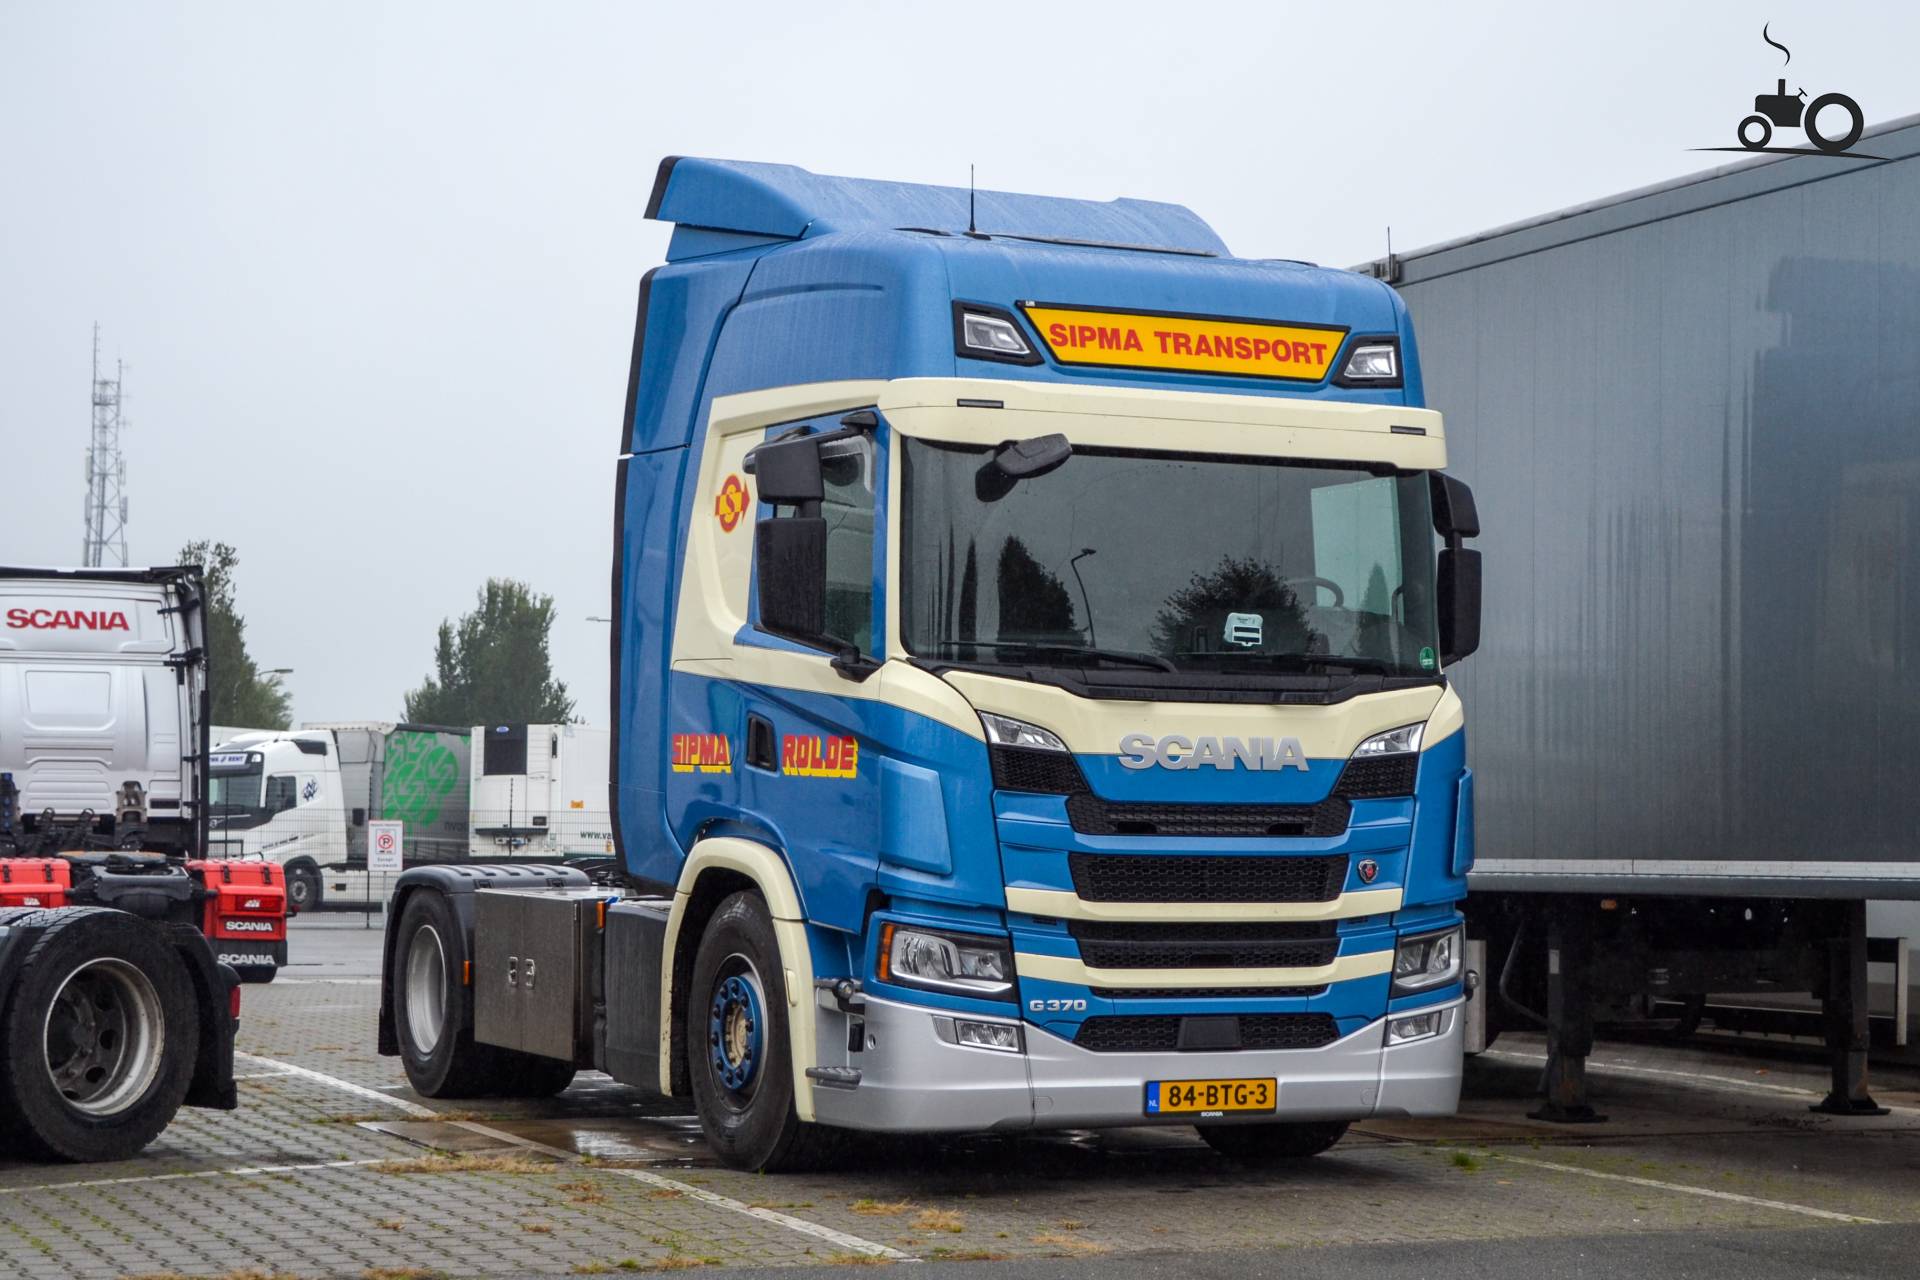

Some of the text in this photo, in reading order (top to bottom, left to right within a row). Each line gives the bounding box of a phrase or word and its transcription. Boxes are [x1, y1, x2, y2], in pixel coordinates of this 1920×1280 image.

[1049, 323, 1328, 365] SIPMA TRANSPORT
[6, 608, 130, 631] SCANIA
[672, 732, 858, 778] SIPMA ROLDE
[1118, 734, 1310, 772] SCANIA
[226, 921, 273, 931] SCANIA
[217, 953, 276, 965] SCANIA
[1030, 1000, 1087, 1011] G 370
[1148, 1083, 1268, 1107] NL 84-BTG-3
